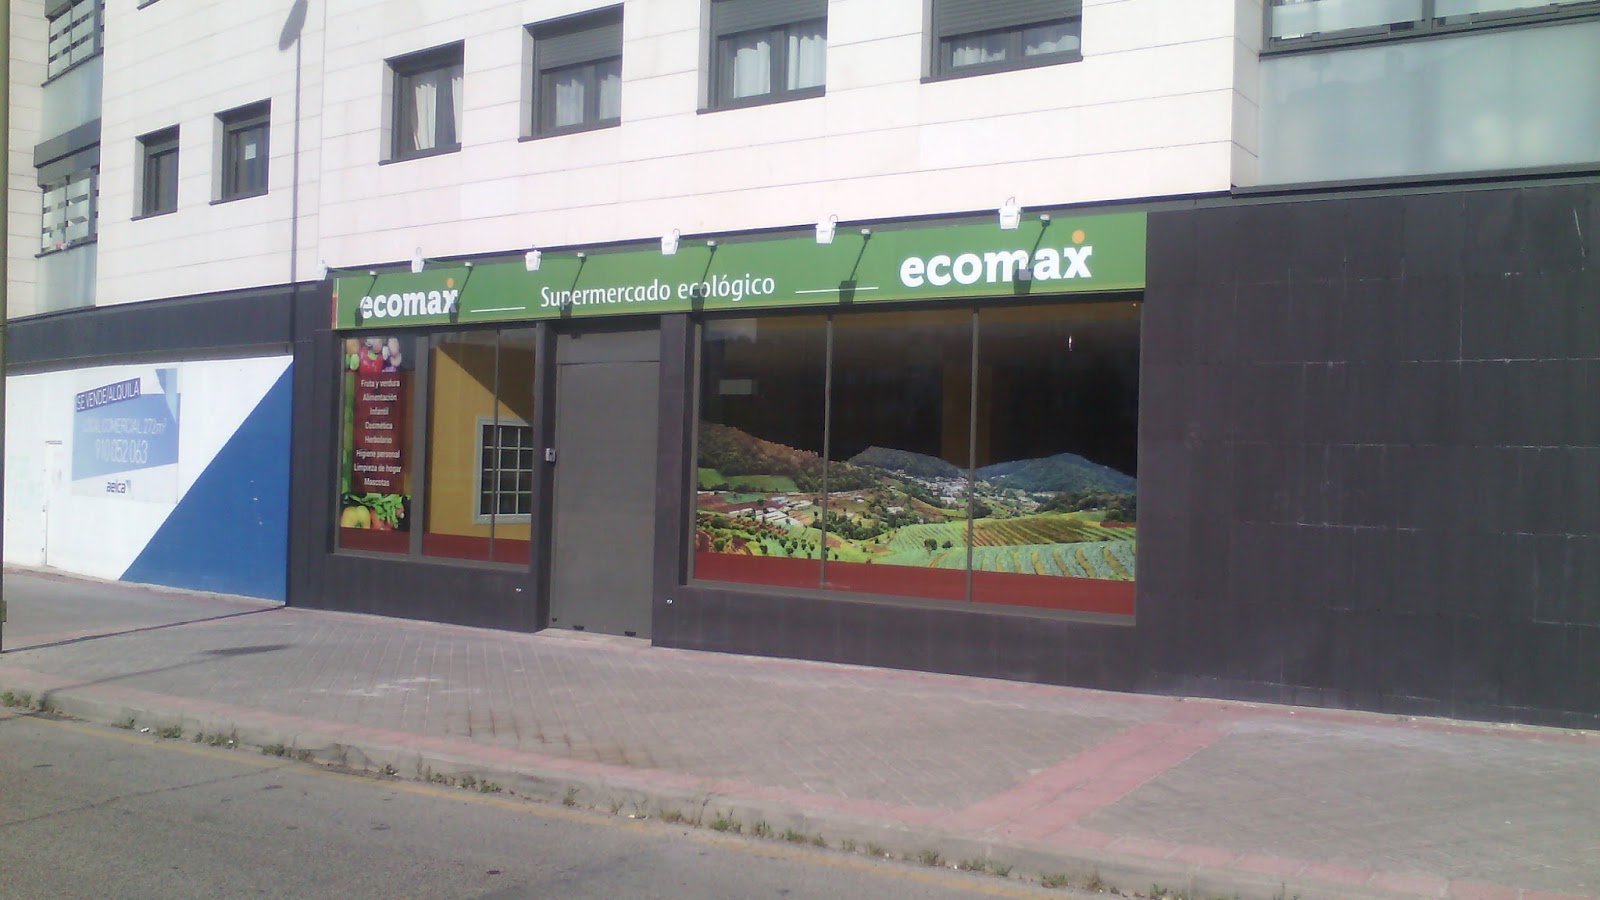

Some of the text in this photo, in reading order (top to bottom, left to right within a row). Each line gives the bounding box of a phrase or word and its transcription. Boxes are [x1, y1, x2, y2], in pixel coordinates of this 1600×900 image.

[900, 245, 1092, 287] ecomax
[540, 273, 775, 310] Supermercado ecológico
[360, 289, 458, 319] ecomax
[361, 379, 375, 388] Fruta
[380, 380, 400, 388] verdura
[76, 381, 139, 411] SE VENDE/ALQUILA
[363, 393, 398, 402] Alimentación
[370, 407, 389, 416] Infantil
[129, 439, 148, 464] 063
[376, 450, 400, 459] personal
[354, 463, 377, 472] Limpieza
[386, 464, 402, 474] hogar
